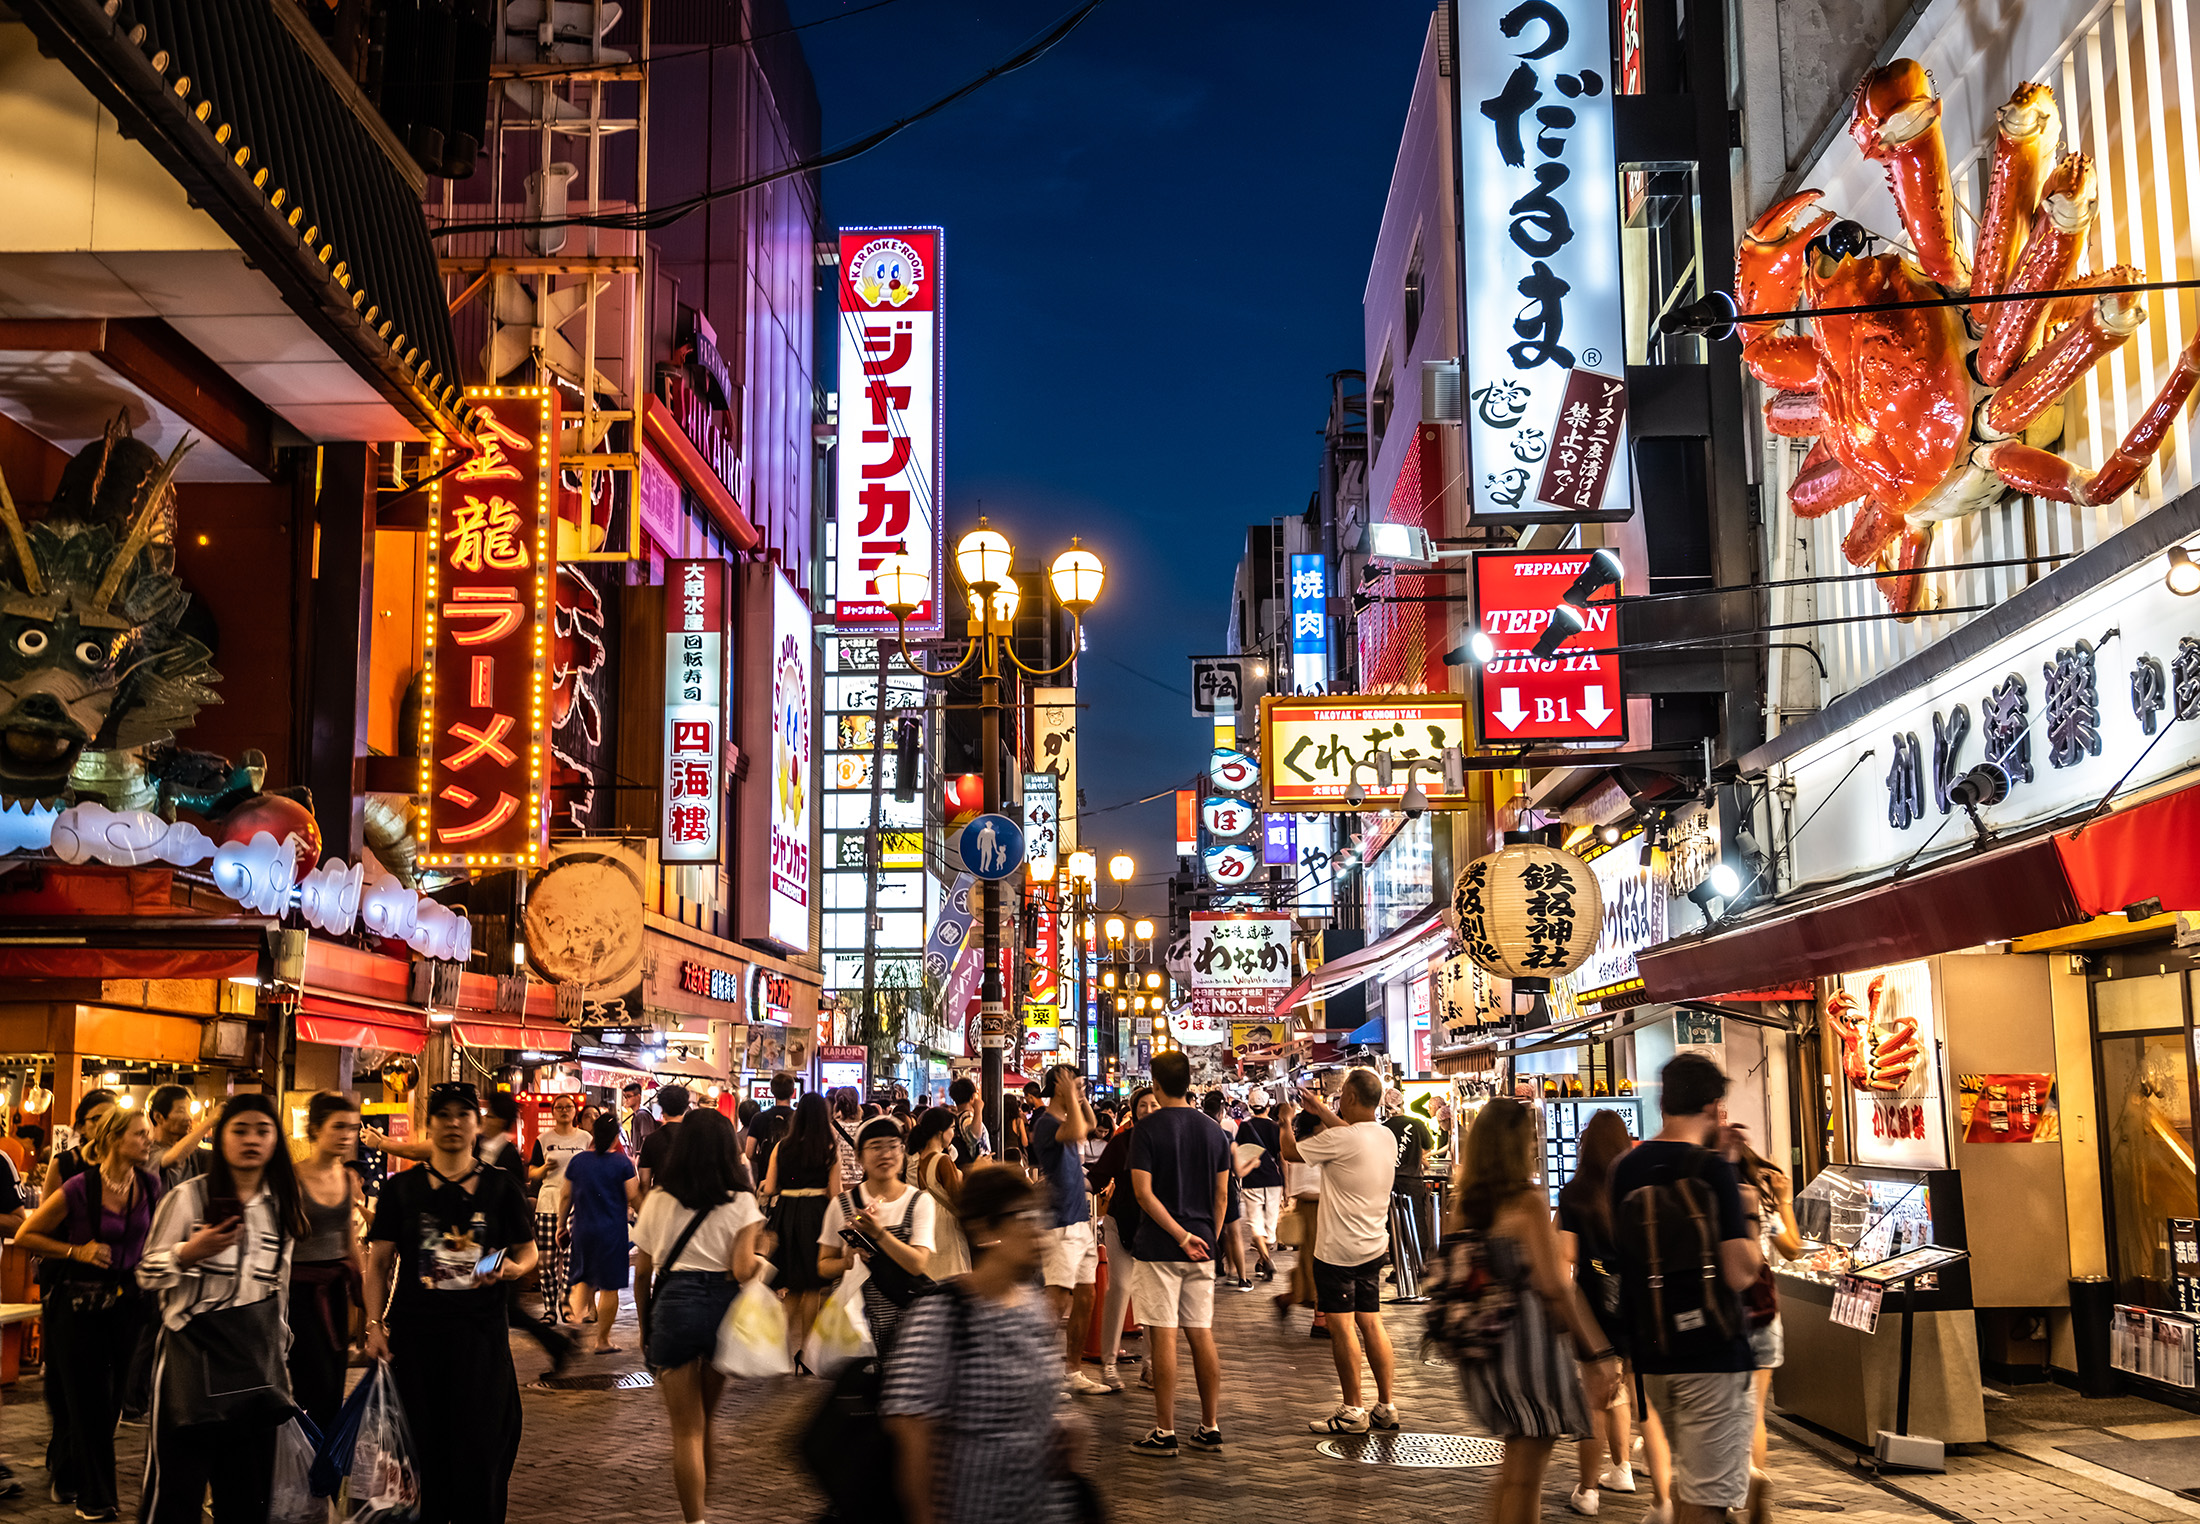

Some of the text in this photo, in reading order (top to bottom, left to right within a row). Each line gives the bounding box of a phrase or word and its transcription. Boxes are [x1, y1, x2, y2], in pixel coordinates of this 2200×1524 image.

[437, 405, 533, 844] 金龍ラーメン
[684, 563, 705, 631] 大起水産
[1292, 570, 1325, 639] 焼肉
[683, 635, 703, 701] 回転寿司
[1201, 672, 1237, 700] 牛角
[1534, 697, 1572, 723] B1
[668, 718, 713, 846] 四海樓
[772, 824, 807, 884] ジャンカラ
[1517, 862, 1577, 969] 鉄板神社
[1193, 937, 1289, 975] わなか
[823, 1047, 863, 1056] KARAOKE
[2174, 1240, 2199, 1264] 満席
